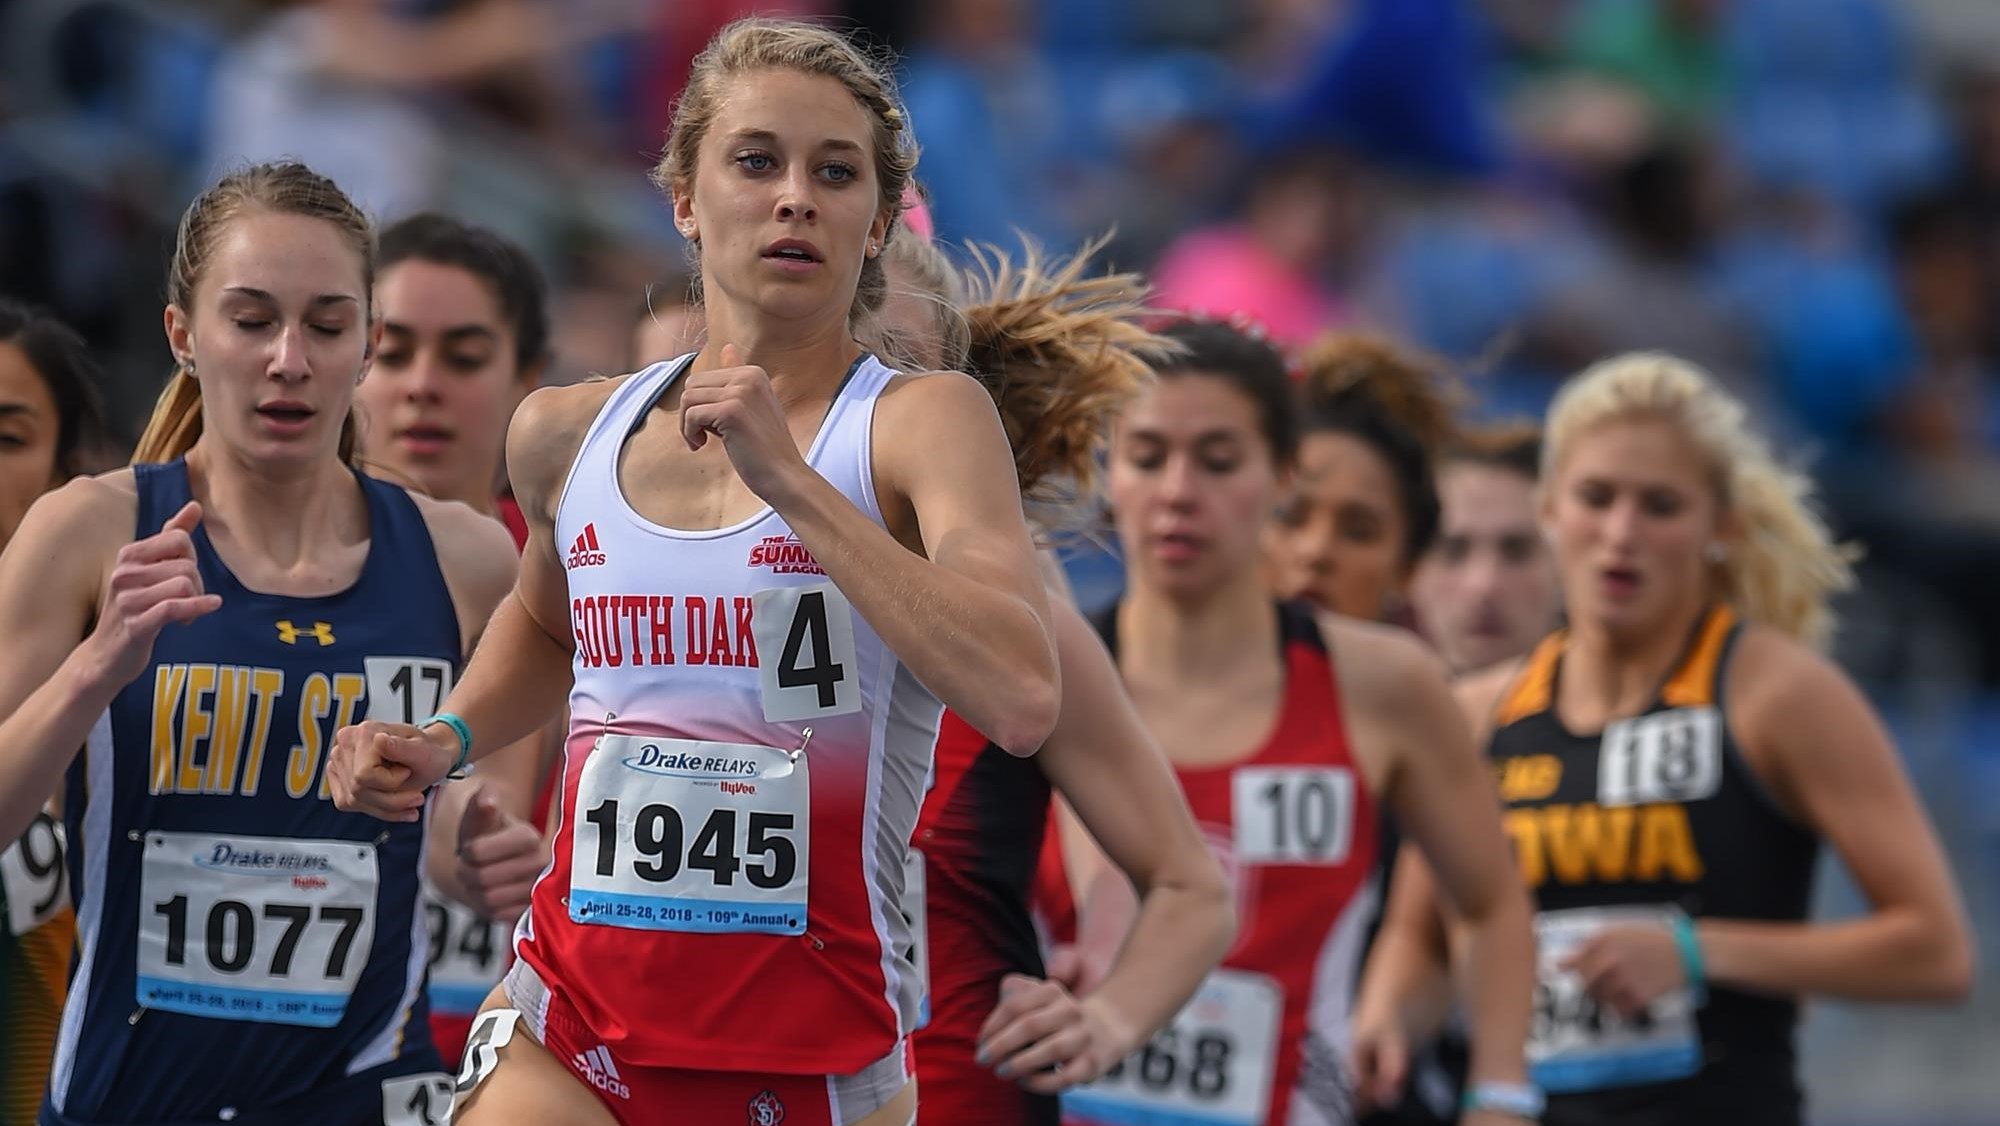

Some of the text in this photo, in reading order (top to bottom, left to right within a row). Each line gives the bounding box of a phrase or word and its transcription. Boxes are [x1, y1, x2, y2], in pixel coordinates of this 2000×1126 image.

[567, 551, 606, 570] adidas
[762, 536, 785, 545] THE
[573, 595, 675, 668] SOUTH
[777, 591, 844, 708] 4
[149, 664, 285, 796] KENT
[637, 744, 757, 775] Drake RELAYS
[1622, 721, 1698, 796] 18
[586, 799, 797, 890] 1945
[1257, 779, 1338, 857] 10
[209, 843, 275, 868] Drake
[155, 895, 364, 978] 1077
[585, 901, 613, 917] April
[617, 904, 656, 921] 25-28,
[660, 908, 693, 922] 2018
[707, 911, 739, 924] 109th
[742, 912, 788, 926] Annual
[1105, 1029, 1233, 1098] 68
